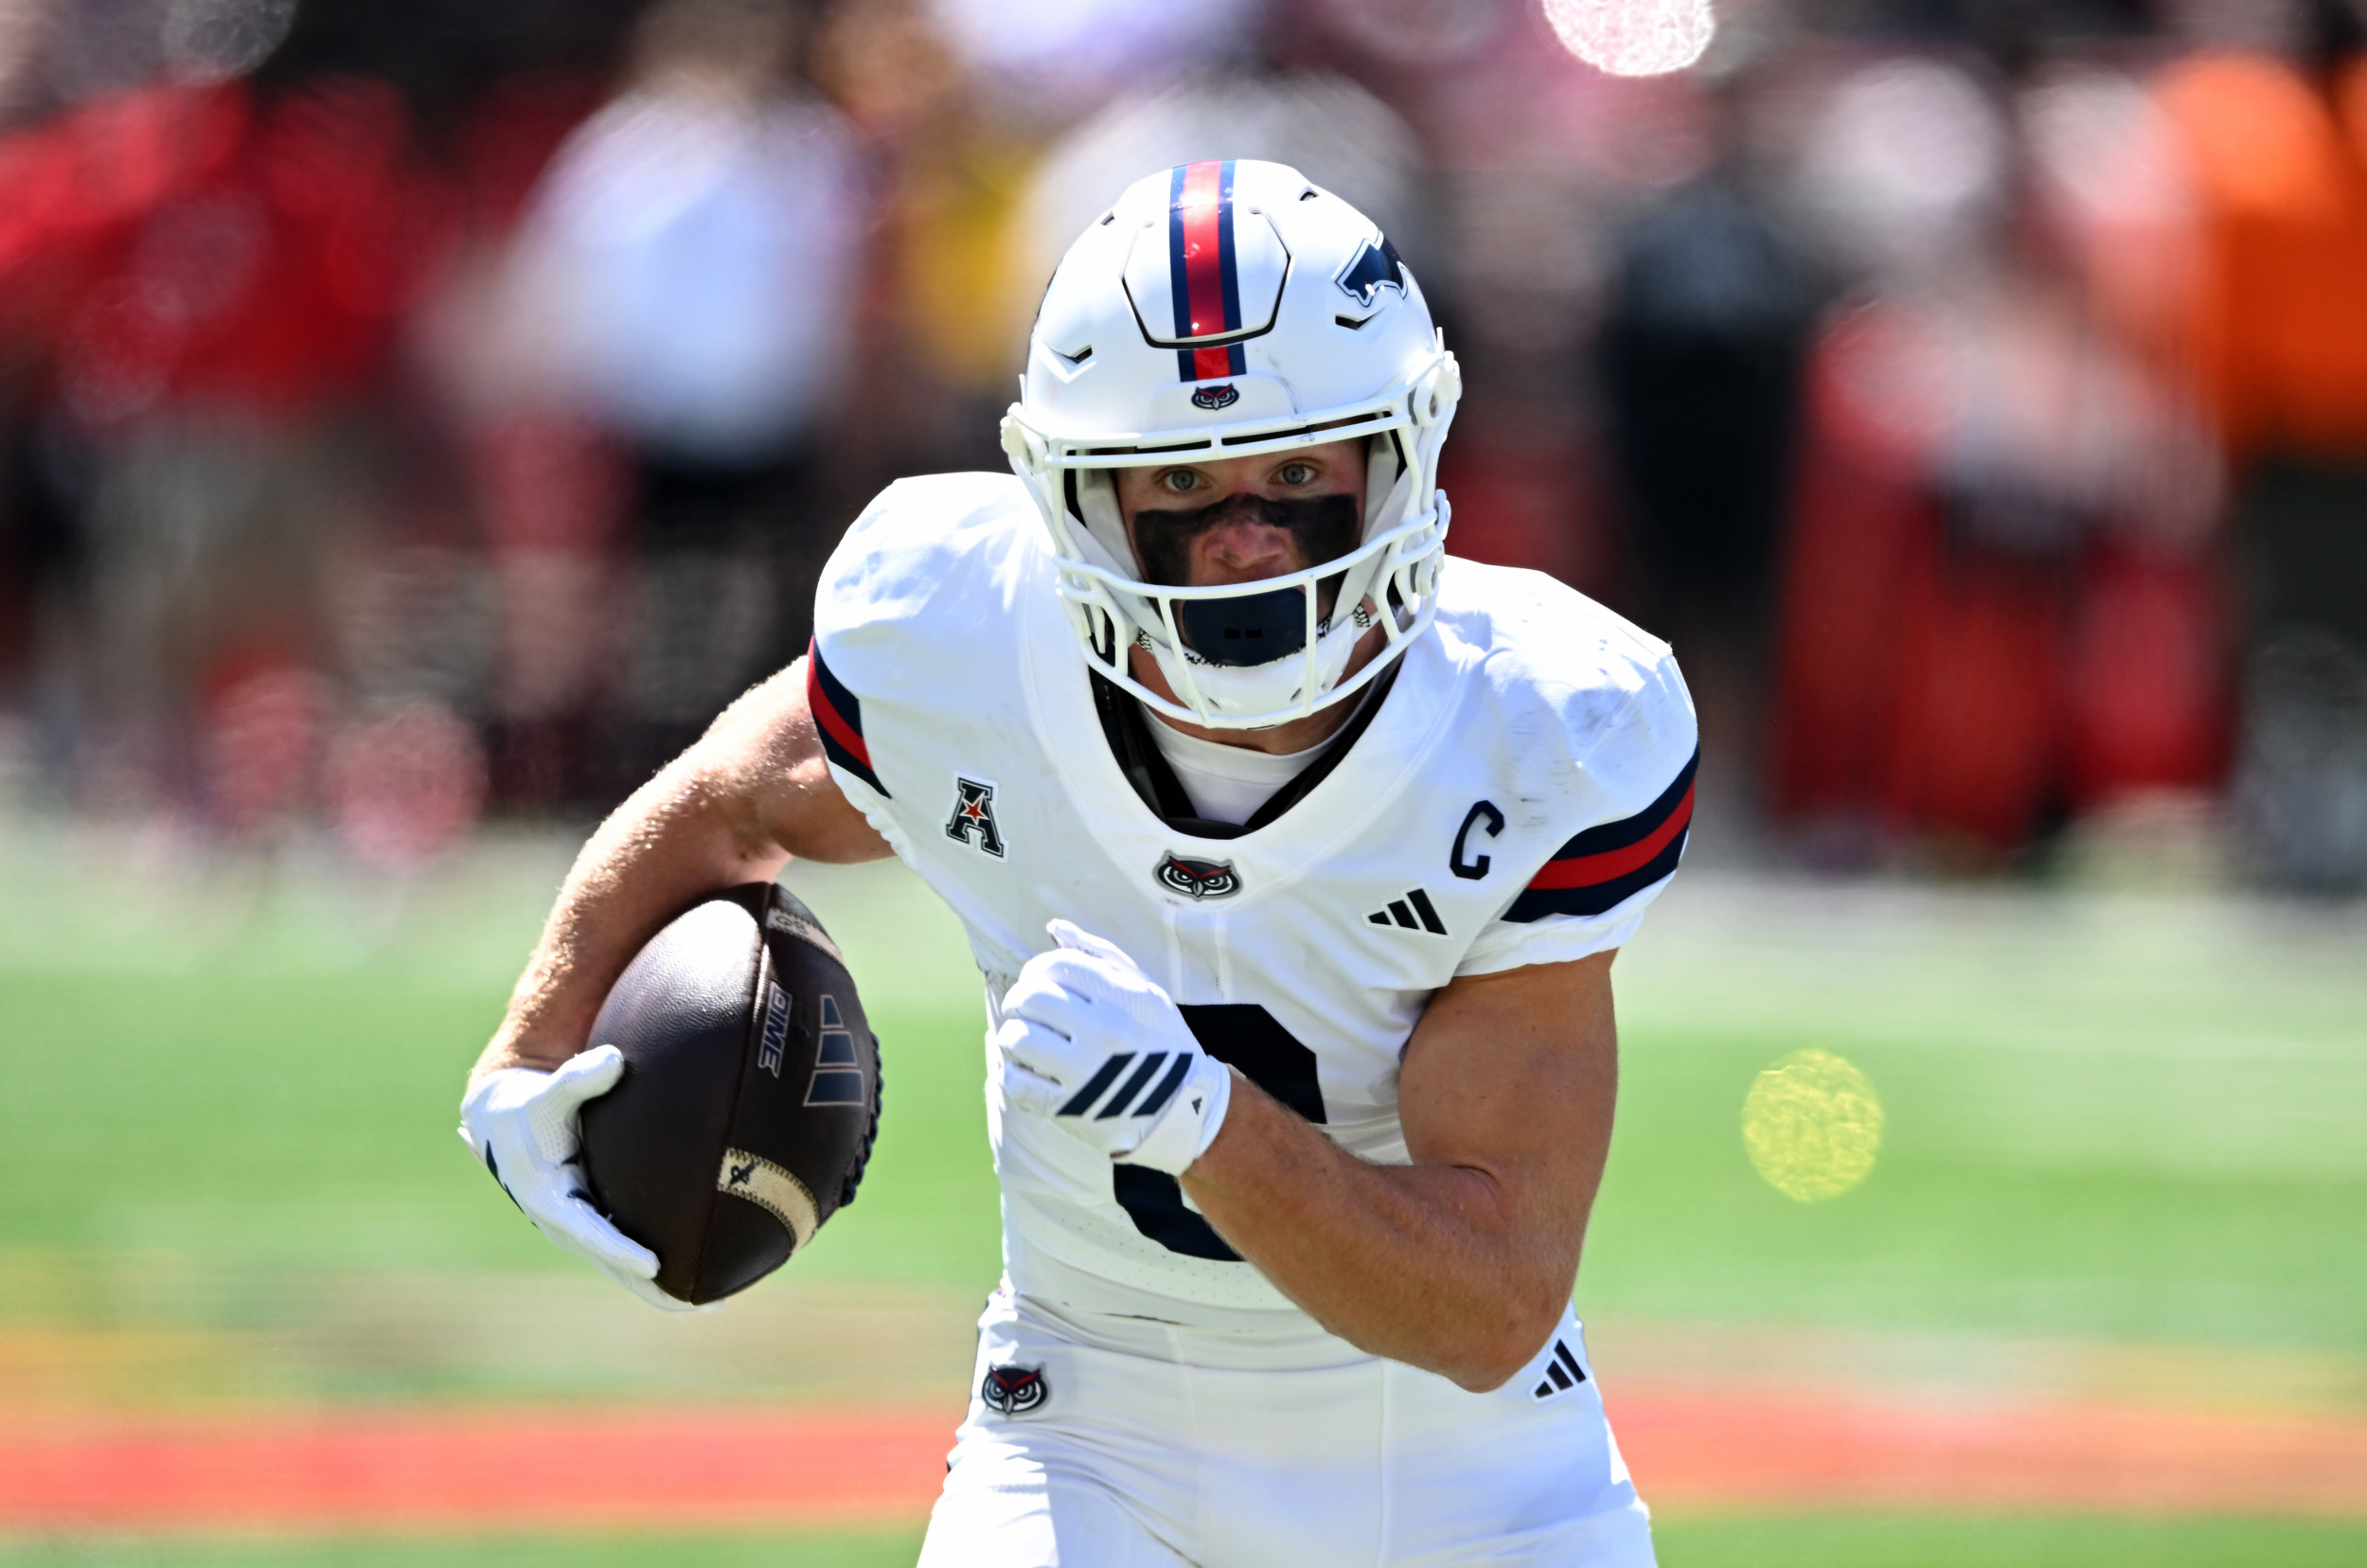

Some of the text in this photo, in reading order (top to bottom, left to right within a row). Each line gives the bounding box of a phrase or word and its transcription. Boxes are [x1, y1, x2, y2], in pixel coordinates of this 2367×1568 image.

[946, 776, 1005, 858] A
[1449, 799, 1505, 881] C
[758, 981, 792, 1078] DIME
